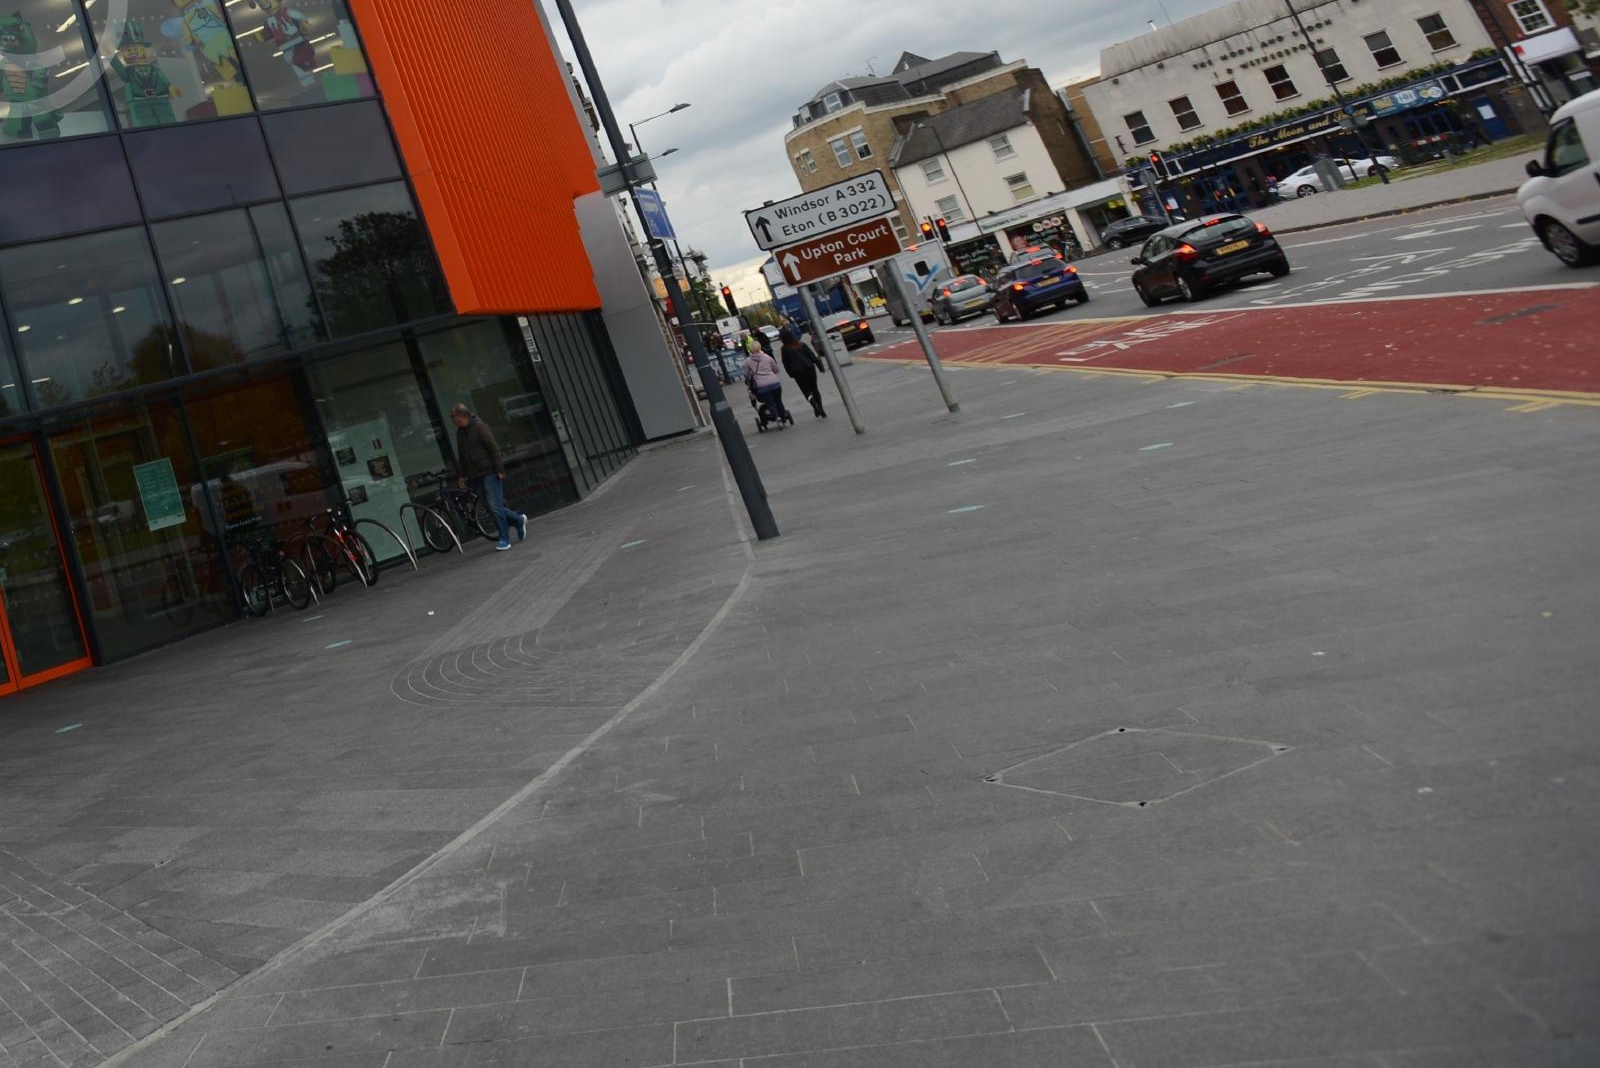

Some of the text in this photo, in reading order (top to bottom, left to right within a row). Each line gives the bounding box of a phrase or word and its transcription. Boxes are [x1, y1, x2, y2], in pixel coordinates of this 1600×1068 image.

[1192, 18, 1332, 70] THE MOON AND SOON
[1249, 135, 1270, 148] The
[1273, 126, 1304, 142] Moon
[1308, 118, 1329, 130] and
[774, 196, 830, 219] Windsor
[782, 220, 815, 236] Eton
[800, 224, 888, 260] Upton Court
[834, 247, 867, 265] Park
